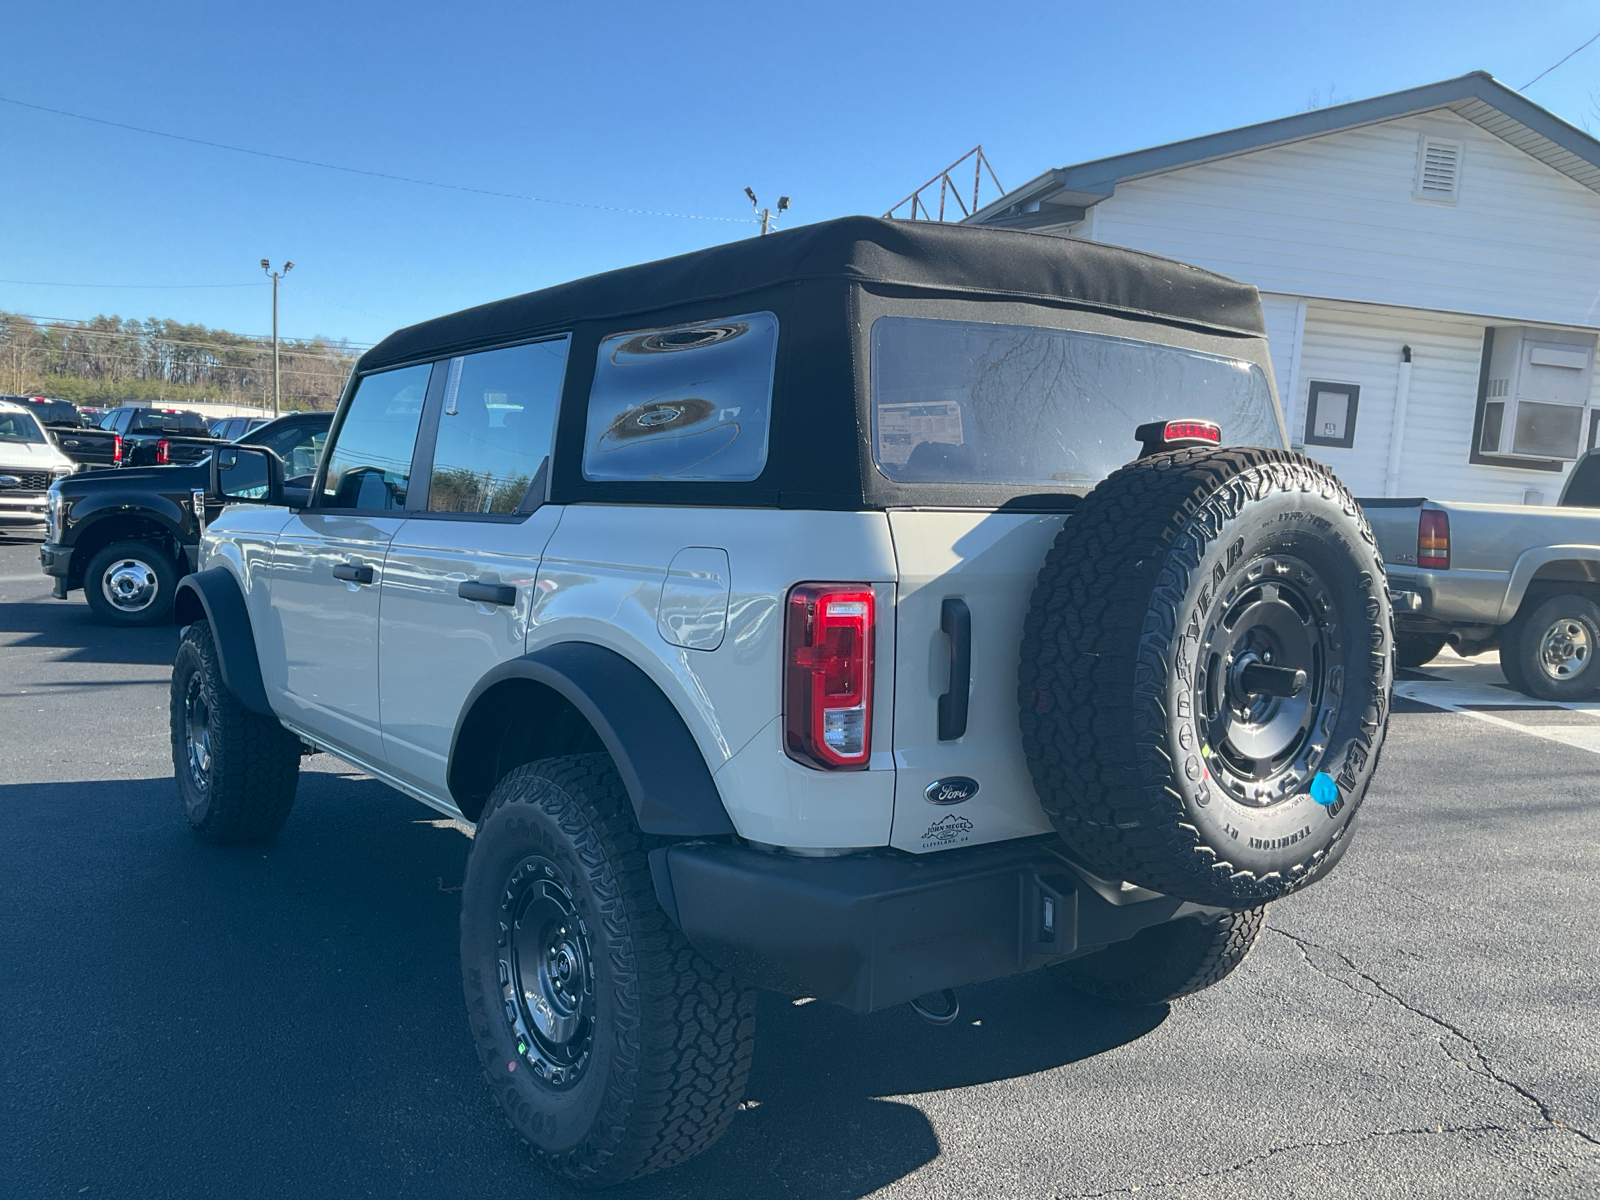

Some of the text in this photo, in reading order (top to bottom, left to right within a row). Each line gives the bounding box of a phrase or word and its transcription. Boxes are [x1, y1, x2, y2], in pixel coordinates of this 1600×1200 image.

[1176, 535, 1245, 808] GOODYEAR
[927, 826, 944, 835] JOHN
[1223, 823, 1311, 850] TERRITORY RT
